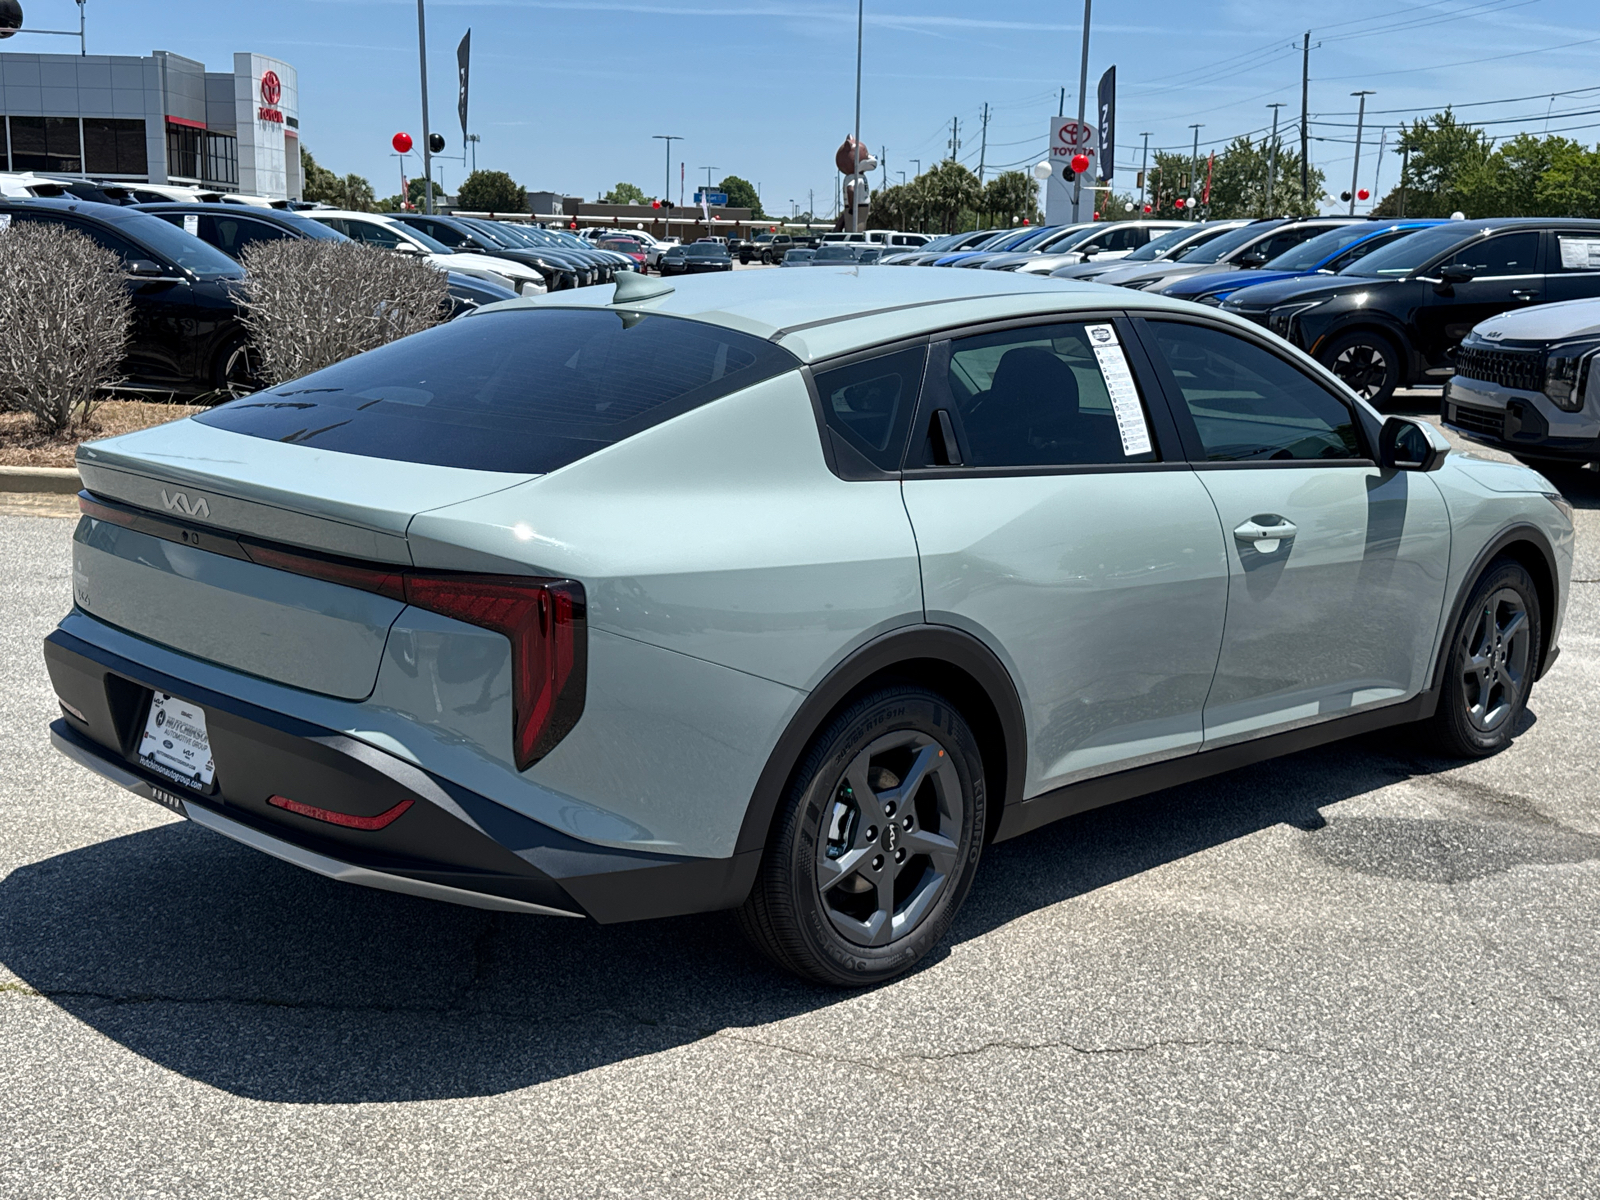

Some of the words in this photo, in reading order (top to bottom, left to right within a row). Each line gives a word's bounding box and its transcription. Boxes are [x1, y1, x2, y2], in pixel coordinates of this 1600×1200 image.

[258, 107, 284, 123] TOYOTA
[160, 488, 211, 519] KIA
[866, 713, 884, 731] R16
[885, 706, 906, 720] 91H
[164, 728, 192, 746] AUTOMOTIVE
[192, 739, 209, 751] GROUP
[183, 749, 194, 757] KIA
[140, 756, 203, 790] Hutchinsonautogroup.com
[970, 779, 983, 863] KUMHO
[816, 930, 866, 972] SOLUS
